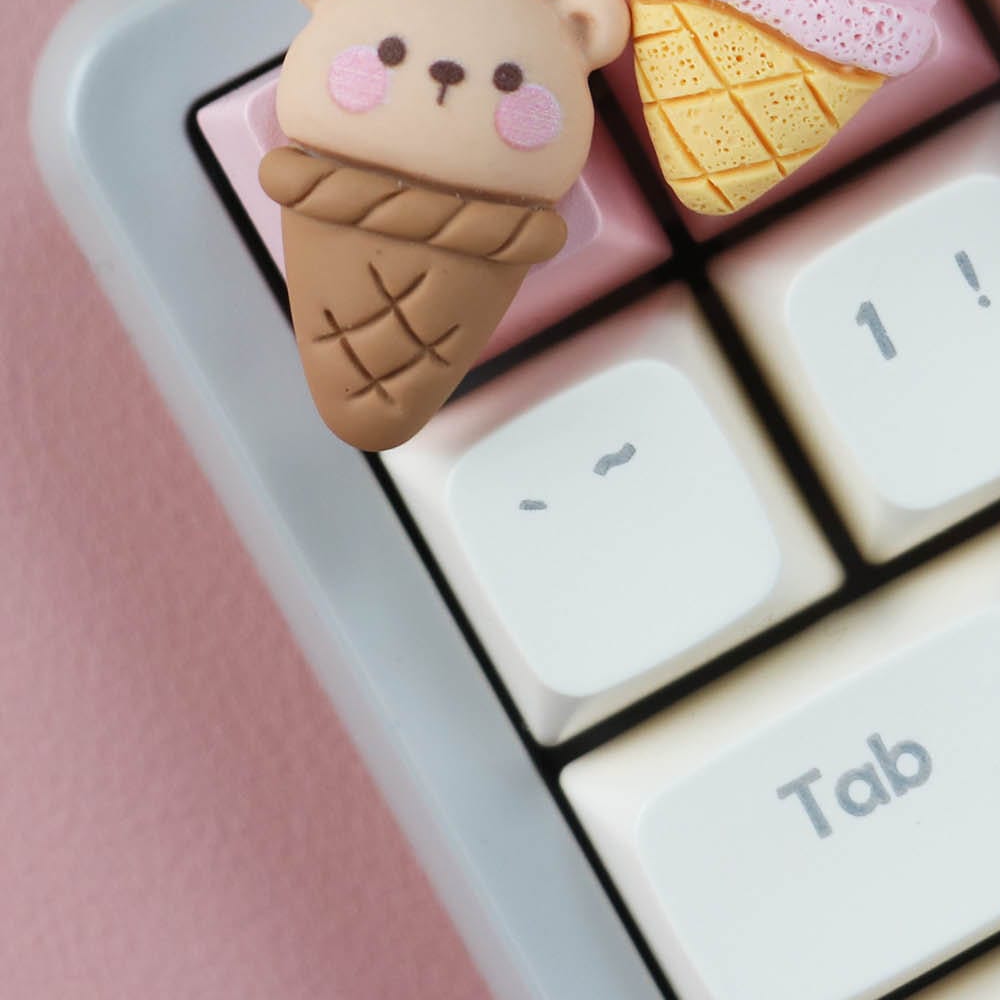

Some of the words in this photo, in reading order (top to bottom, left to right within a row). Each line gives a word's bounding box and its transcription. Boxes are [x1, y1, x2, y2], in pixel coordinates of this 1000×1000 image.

[854, 299, 898, 361] 1
[953, 249, 992, 309] !
[775, 732, 933, 840] Tab
